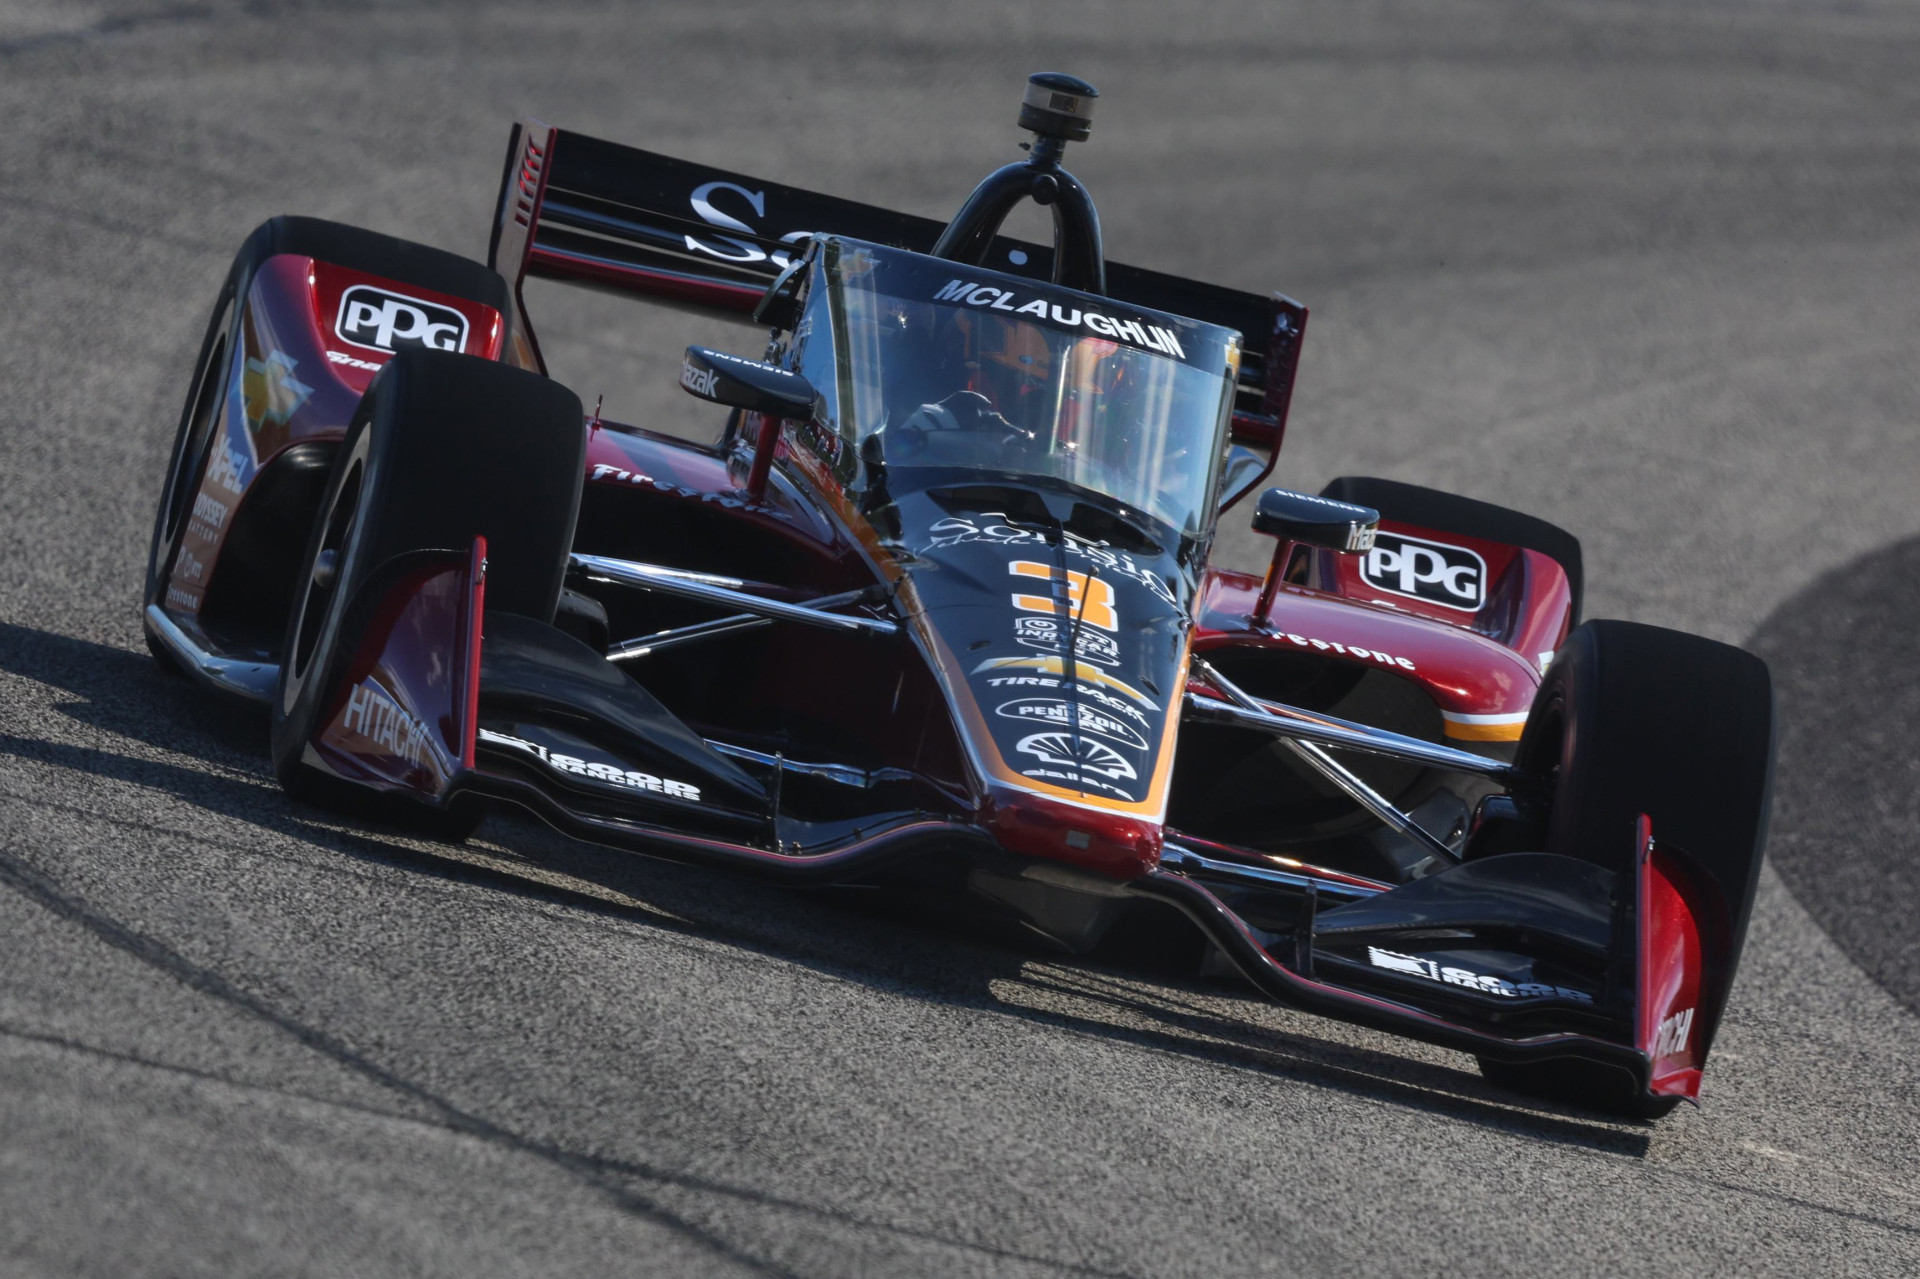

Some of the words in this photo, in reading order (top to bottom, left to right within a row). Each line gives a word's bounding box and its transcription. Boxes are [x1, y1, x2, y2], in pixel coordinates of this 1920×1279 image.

[344, 299, 459, 352] PPG
[933, 279, 1186, 359] MCLAUGHLIN
[703, 350, 794, 377] SIEMENS
[206, 433, 249, 495] XPEL
[1275, 489, 1366, 513] SIEMENS
[1008, 560, 1119, 633] 3
[1368, 543, 1477, 600] PPG
[344, 683, 425, 769] HITACHI
[987, 676, 1060, 688] TIRE
[1063, 683, 1151, 730] RACK
[1019, 706, 1128, 736] PENNZOIL
[550, 754, 701, 794] GOOD
[550, 760, 701, 801] RANCHERS
[1441, 967, 1593, 1000] GOOD
